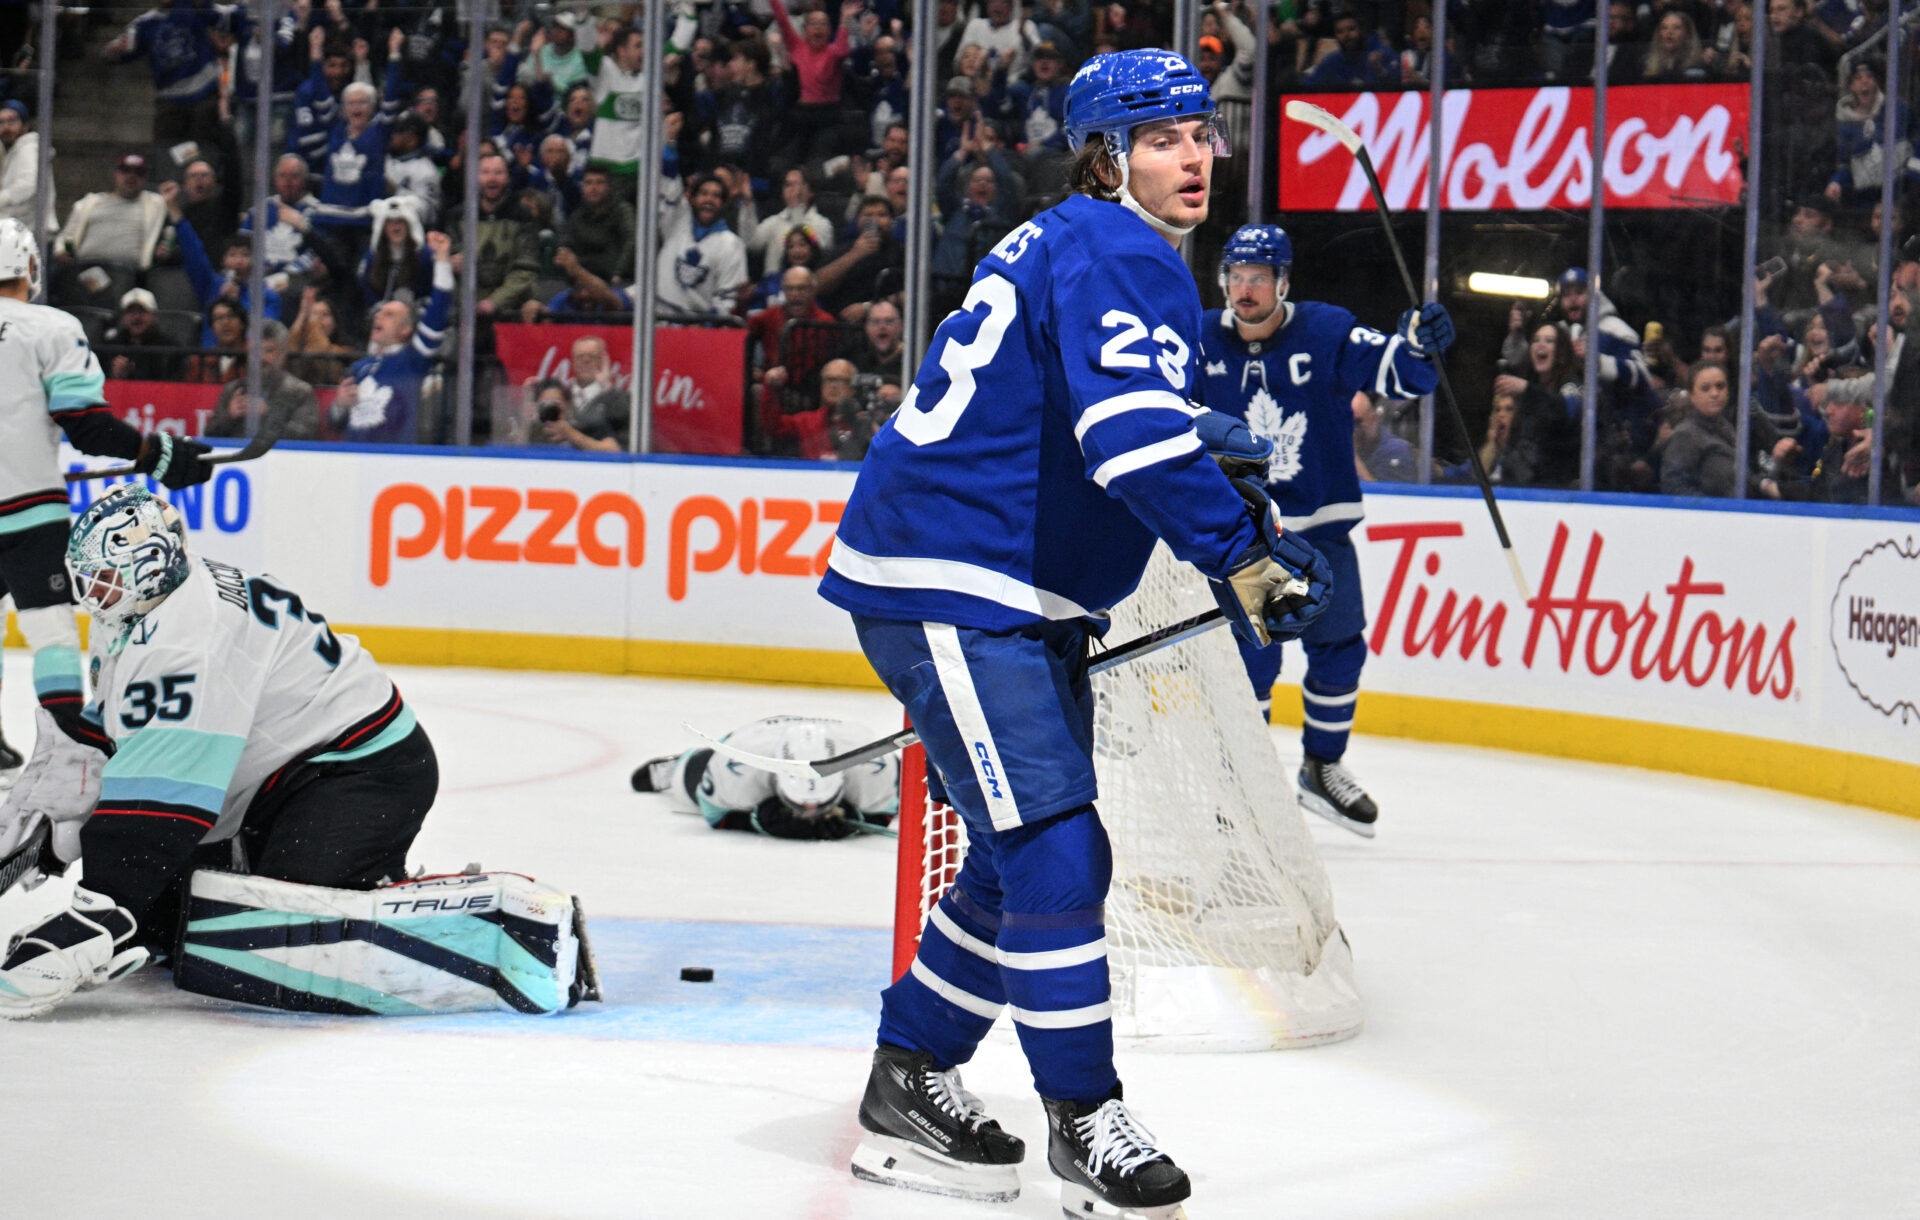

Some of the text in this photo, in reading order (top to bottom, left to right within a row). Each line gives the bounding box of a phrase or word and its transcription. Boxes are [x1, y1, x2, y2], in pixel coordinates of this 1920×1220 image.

[1169, 84, 1204, 96] CCM
[1296, 86, 1734, 209] Molson
[1101, 309, 1190, 390] 23
[1288, 352, 1312, 386] C
[369, 482, 646, 587] pizza
[1366, 520, 1798, 701] Tim Hortons
[1849, 595, 1920, 658] Häagen
[119, 674, 197, 731] 35
[974, 741, 1003, 800] CCM
[382, 894, 495, 914] TRUE
[907, 1109, 953, 1146] BAUER
